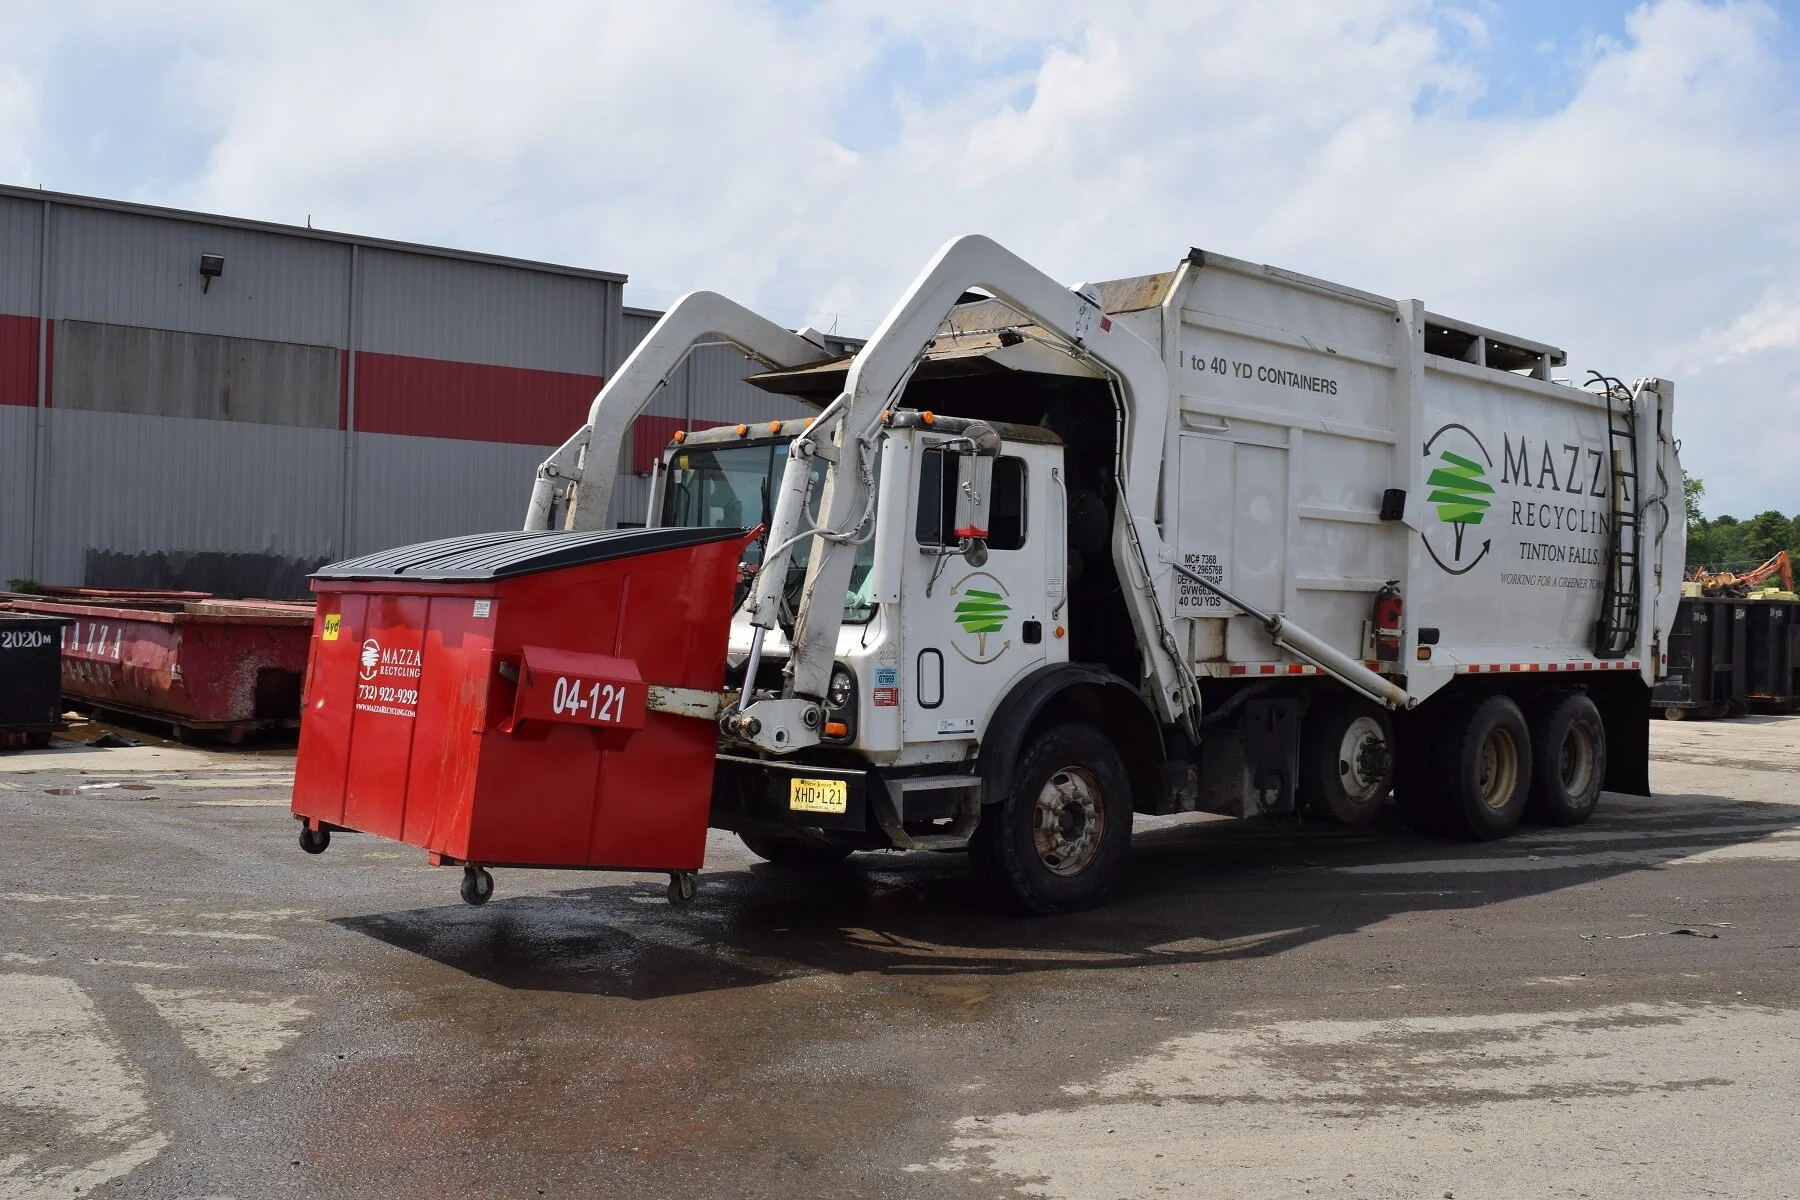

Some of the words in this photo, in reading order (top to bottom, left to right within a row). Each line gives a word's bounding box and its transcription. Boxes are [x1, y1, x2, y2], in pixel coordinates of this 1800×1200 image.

[1191, 355, 1206, 371] to
[1210, 357, 1227, 375] 40
[1232, 362, 1253, 379] YD
[1257, 366, 1338, 395] CONTAINERS
[1511, 500, 1611, 536] RECYCLIN
[1185, 554, 1200, 564] MC#
[1202, 555, 1216, 564] 7368
[1519, 542, 1566, 562] TINTON
[1568, 546, 1600, 567] FALLS,
[1501, 572, 1537, 587] WORKING
[1538, 575, 1552, 588] FOR
[1551, 578, 1557, 589] A
[1559, 576, 1588, 590] GREENER
[1179, 597, 1189, 606] 40
[1191, 597, 1203, 606] CU
[1204, 597, 1221, 606] YDS
[381, 648, 421, 666] MAZZA
[380, 666, 421, 678] RECYCLING
[379, 686, 418, 705] 922-9292
[553, 677, 625, 722] 04-121
[795, 787, 815, 803] XHD
[822, 789, 842, 805] L21
